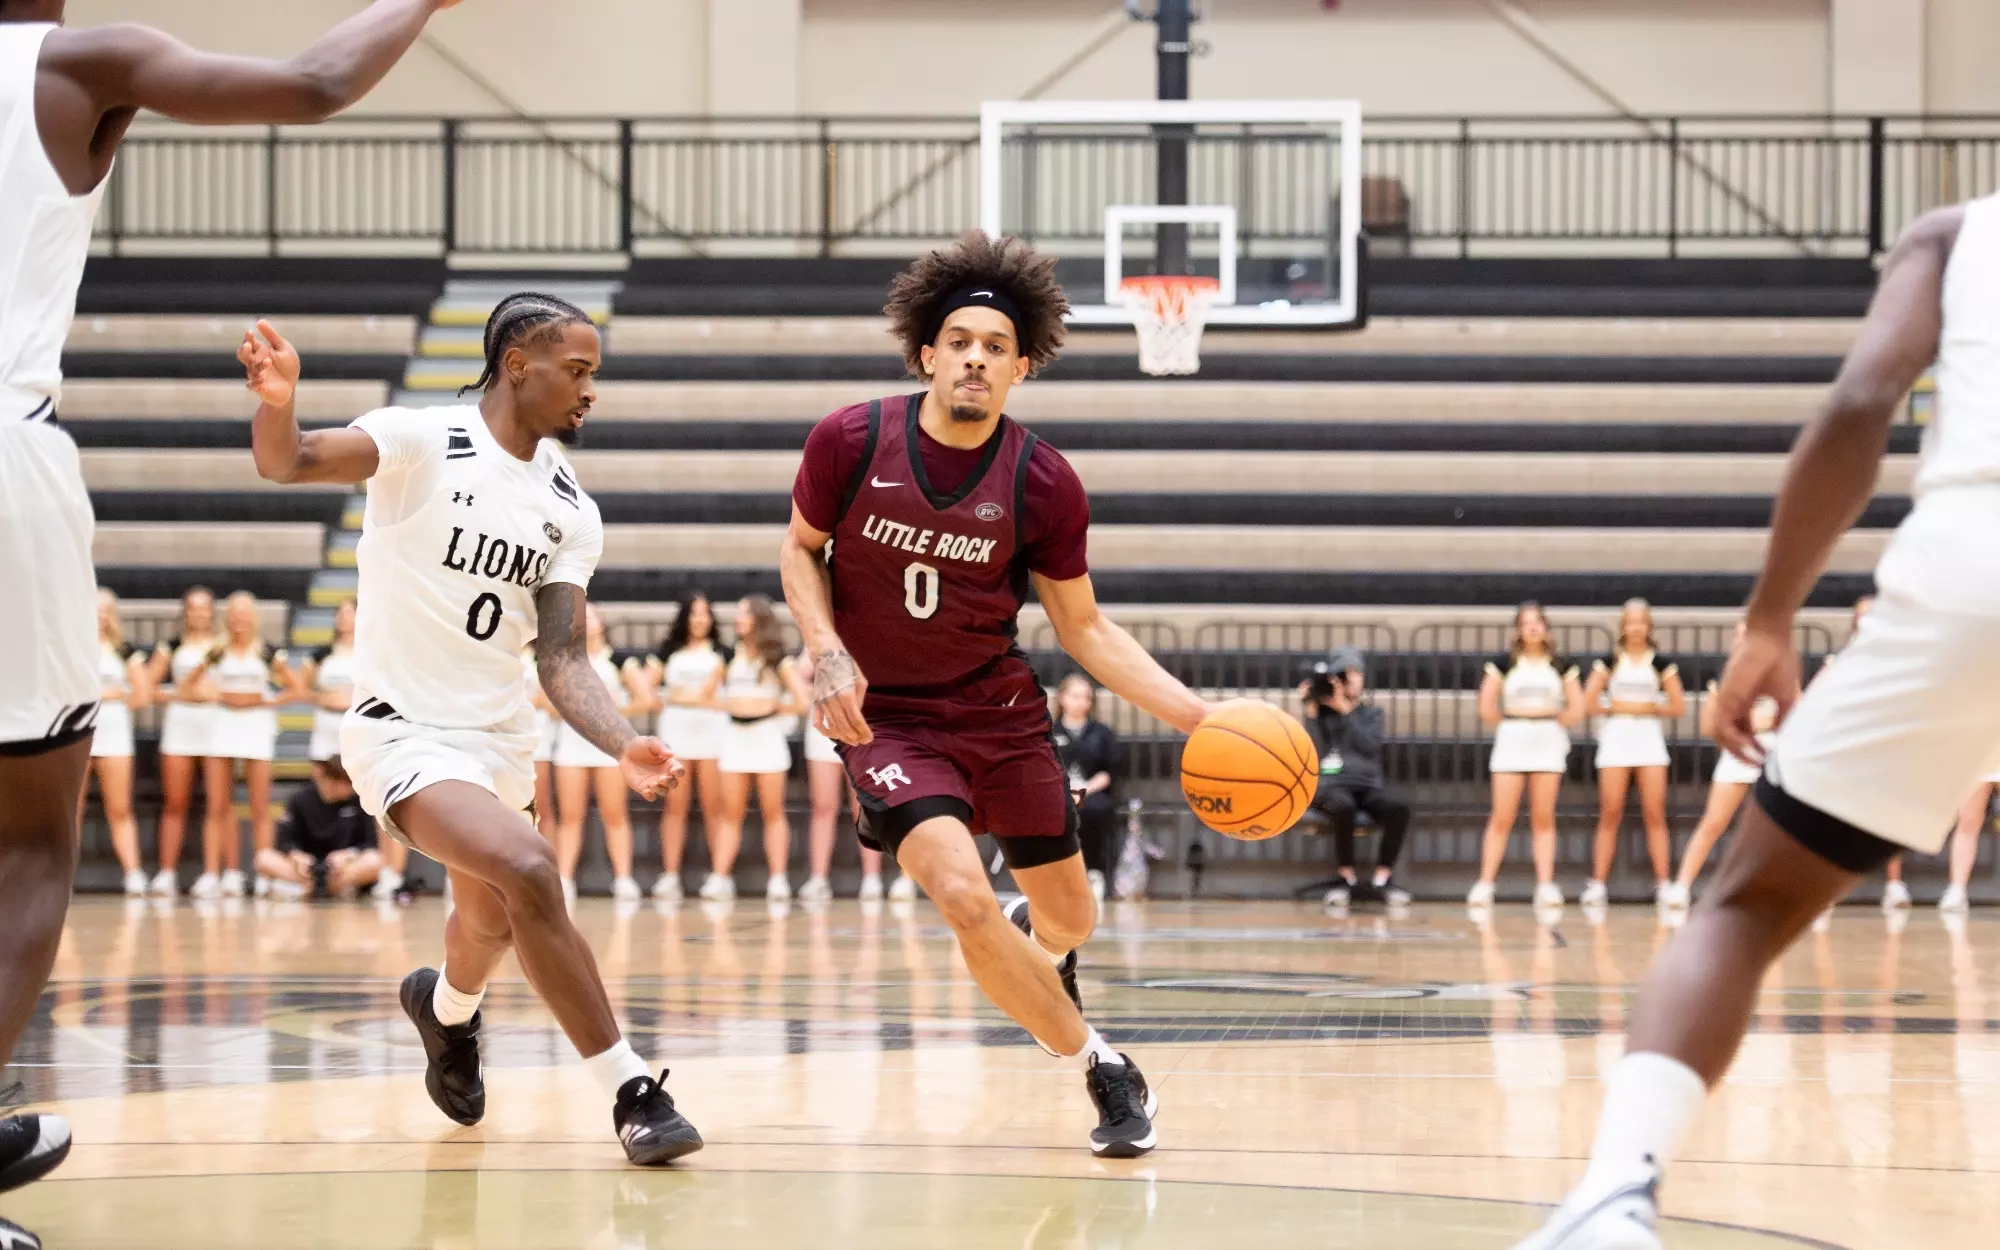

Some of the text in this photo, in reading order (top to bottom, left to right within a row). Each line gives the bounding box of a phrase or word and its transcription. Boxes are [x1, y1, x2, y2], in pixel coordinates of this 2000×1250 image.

[442, 526, 549, 588] LIONS
[862, 514, 997, 563] LITTLE ROCK
[904, 562, 939, 619] 0
[466, 592, 503, 641] 0
[1186, 791, 1233, 814] NCA
